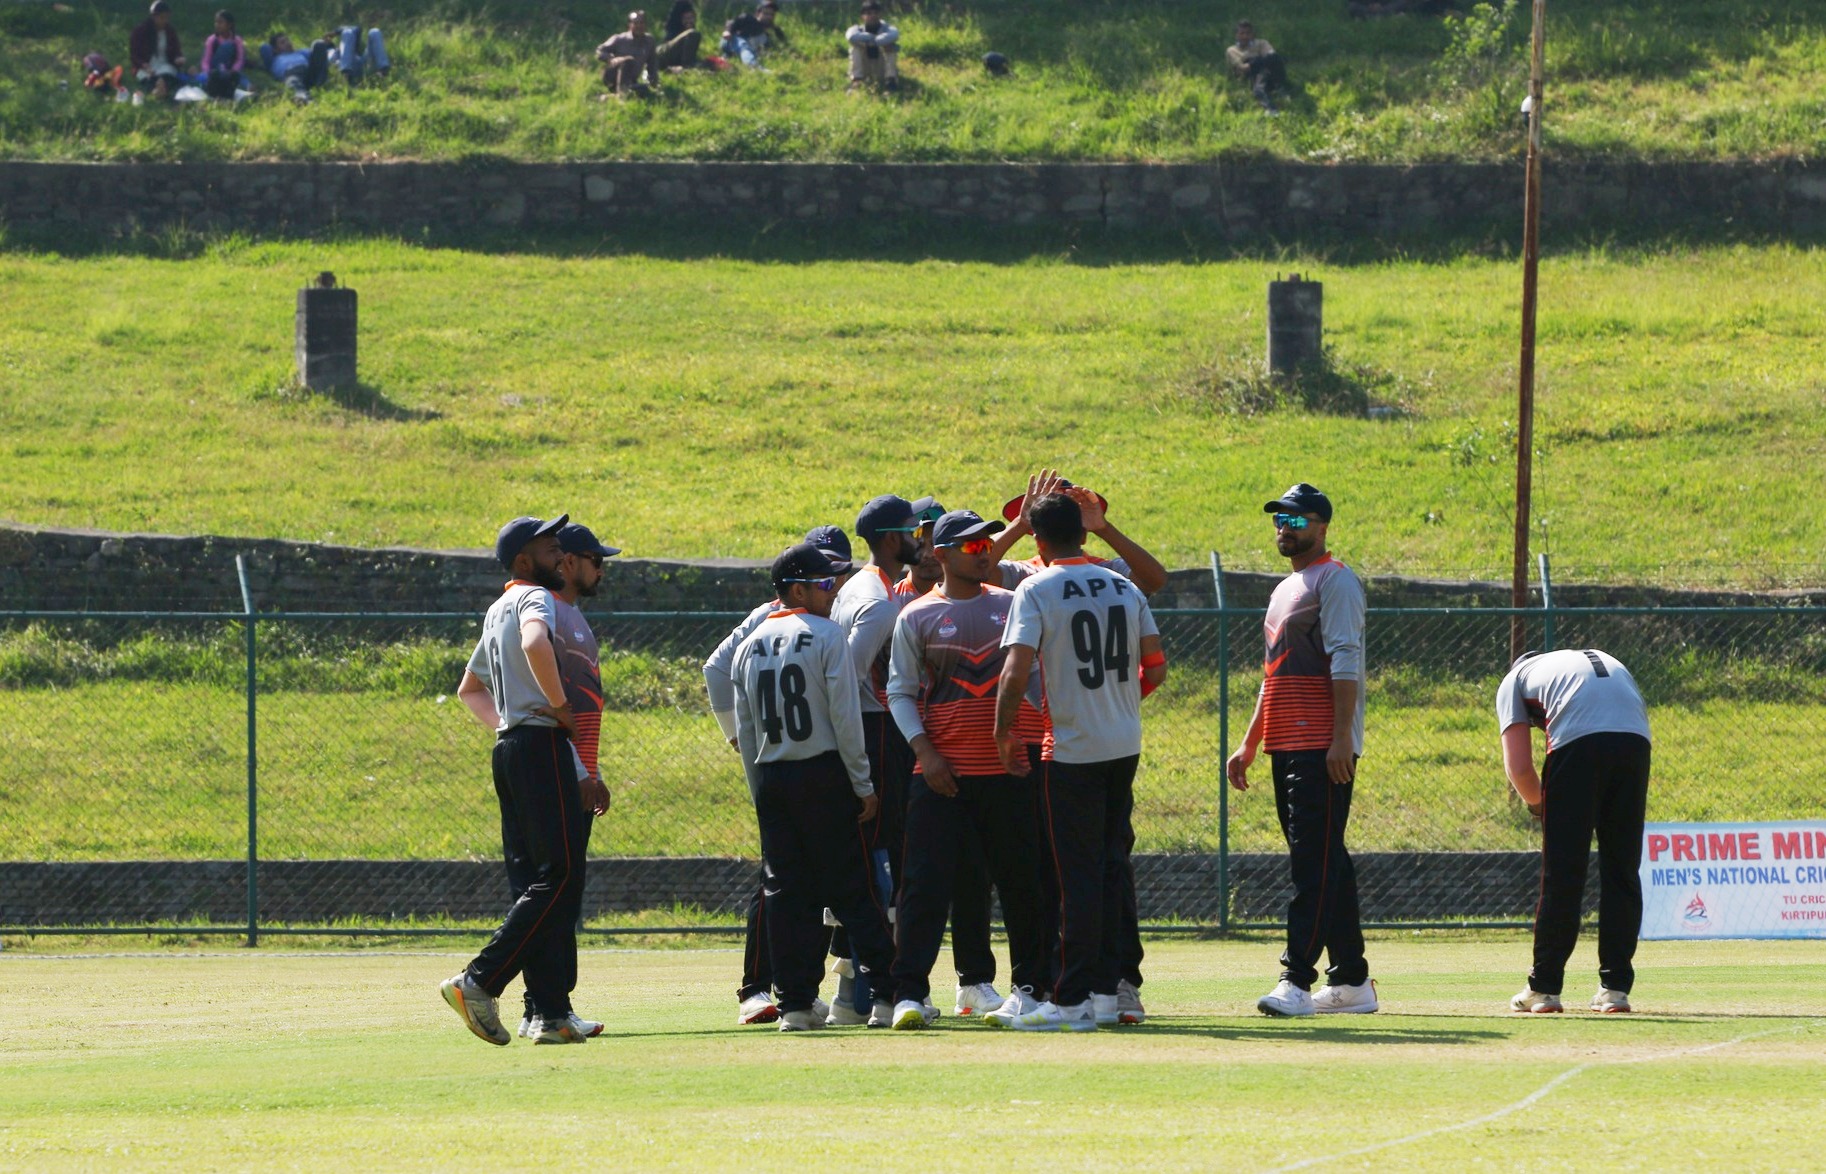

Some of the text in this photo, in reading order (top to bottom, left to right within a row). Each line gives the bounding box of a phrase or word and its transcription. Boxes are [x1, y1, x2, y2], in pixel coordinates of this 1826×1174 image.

[1063, 578, 1128, 600] APF
[750, 633, 814, 658] APF
[1071, 604, 1130, 690] 94
[757, 663, 813, 744] 48
[1647, 832, 1761, 862] PRIME
[1652, 866, 1826, 886] MEN'S NATIONAL CRI
[1783, 895, 1797, 905] TU
[1781, 910, 1826, 920] KIRTIPU
